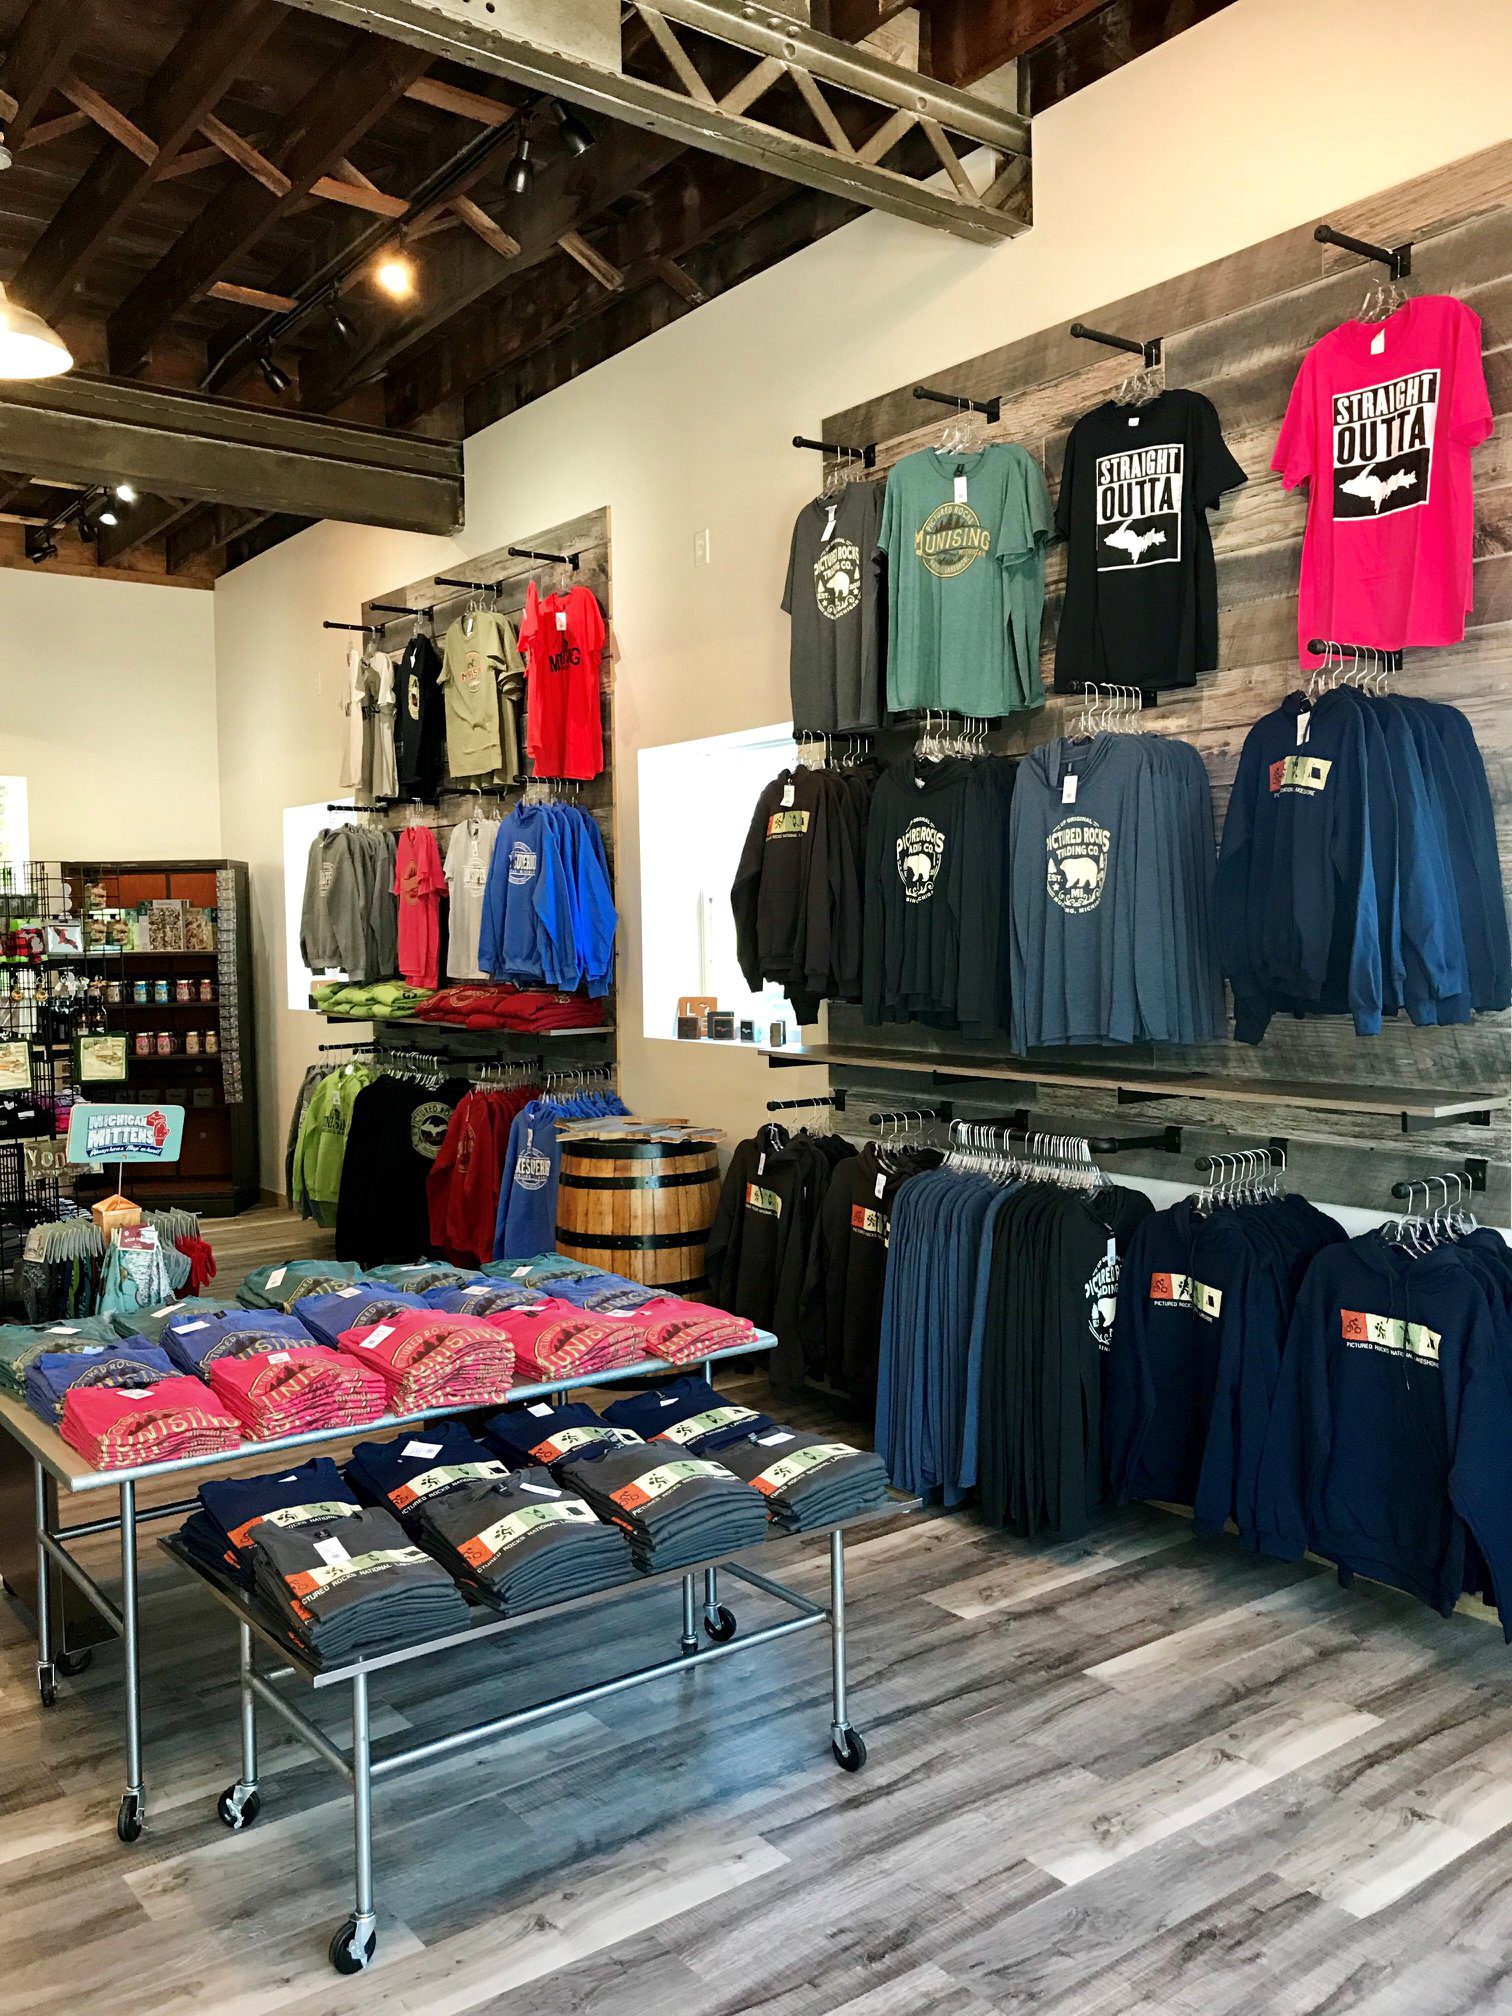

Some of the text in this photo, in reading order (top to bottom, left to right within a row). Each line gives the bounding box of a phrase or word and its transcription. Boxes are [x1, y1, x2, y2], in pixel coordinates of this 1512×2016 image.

[1336, 373, 1434, 425] STRAIGHT
[1336, 405, 1426, 466] OUTTA
[1100, 448, 1178, 485] STRAIGHT
[1101, 475, 1174, 522] OUTTA
[925, 506, 953, 532] PICTURED
[87, 1127, 154, 1149] MITTENS
[88, 1113, 147, 1130] MICHIGAN
[1346, 1341, 1373, 1350] PICTURED
[1374, 1345, 1390, 1353] ROCKS
[401, 1496, 428, 1515] ICTURED
[428, 1484, 451, 1498] ROCKS
[476, 1552, 502, 1574] CTURED
[502, 1535, 526, 1552] ROCKS
[526, 1521, 559, 1536] NATIONAL
[301, 1584, 330, 1606] CTURED
[331, 1573, 358, 1588] ROCKS
[358, 1563, 393, 1577] NATIONAL
